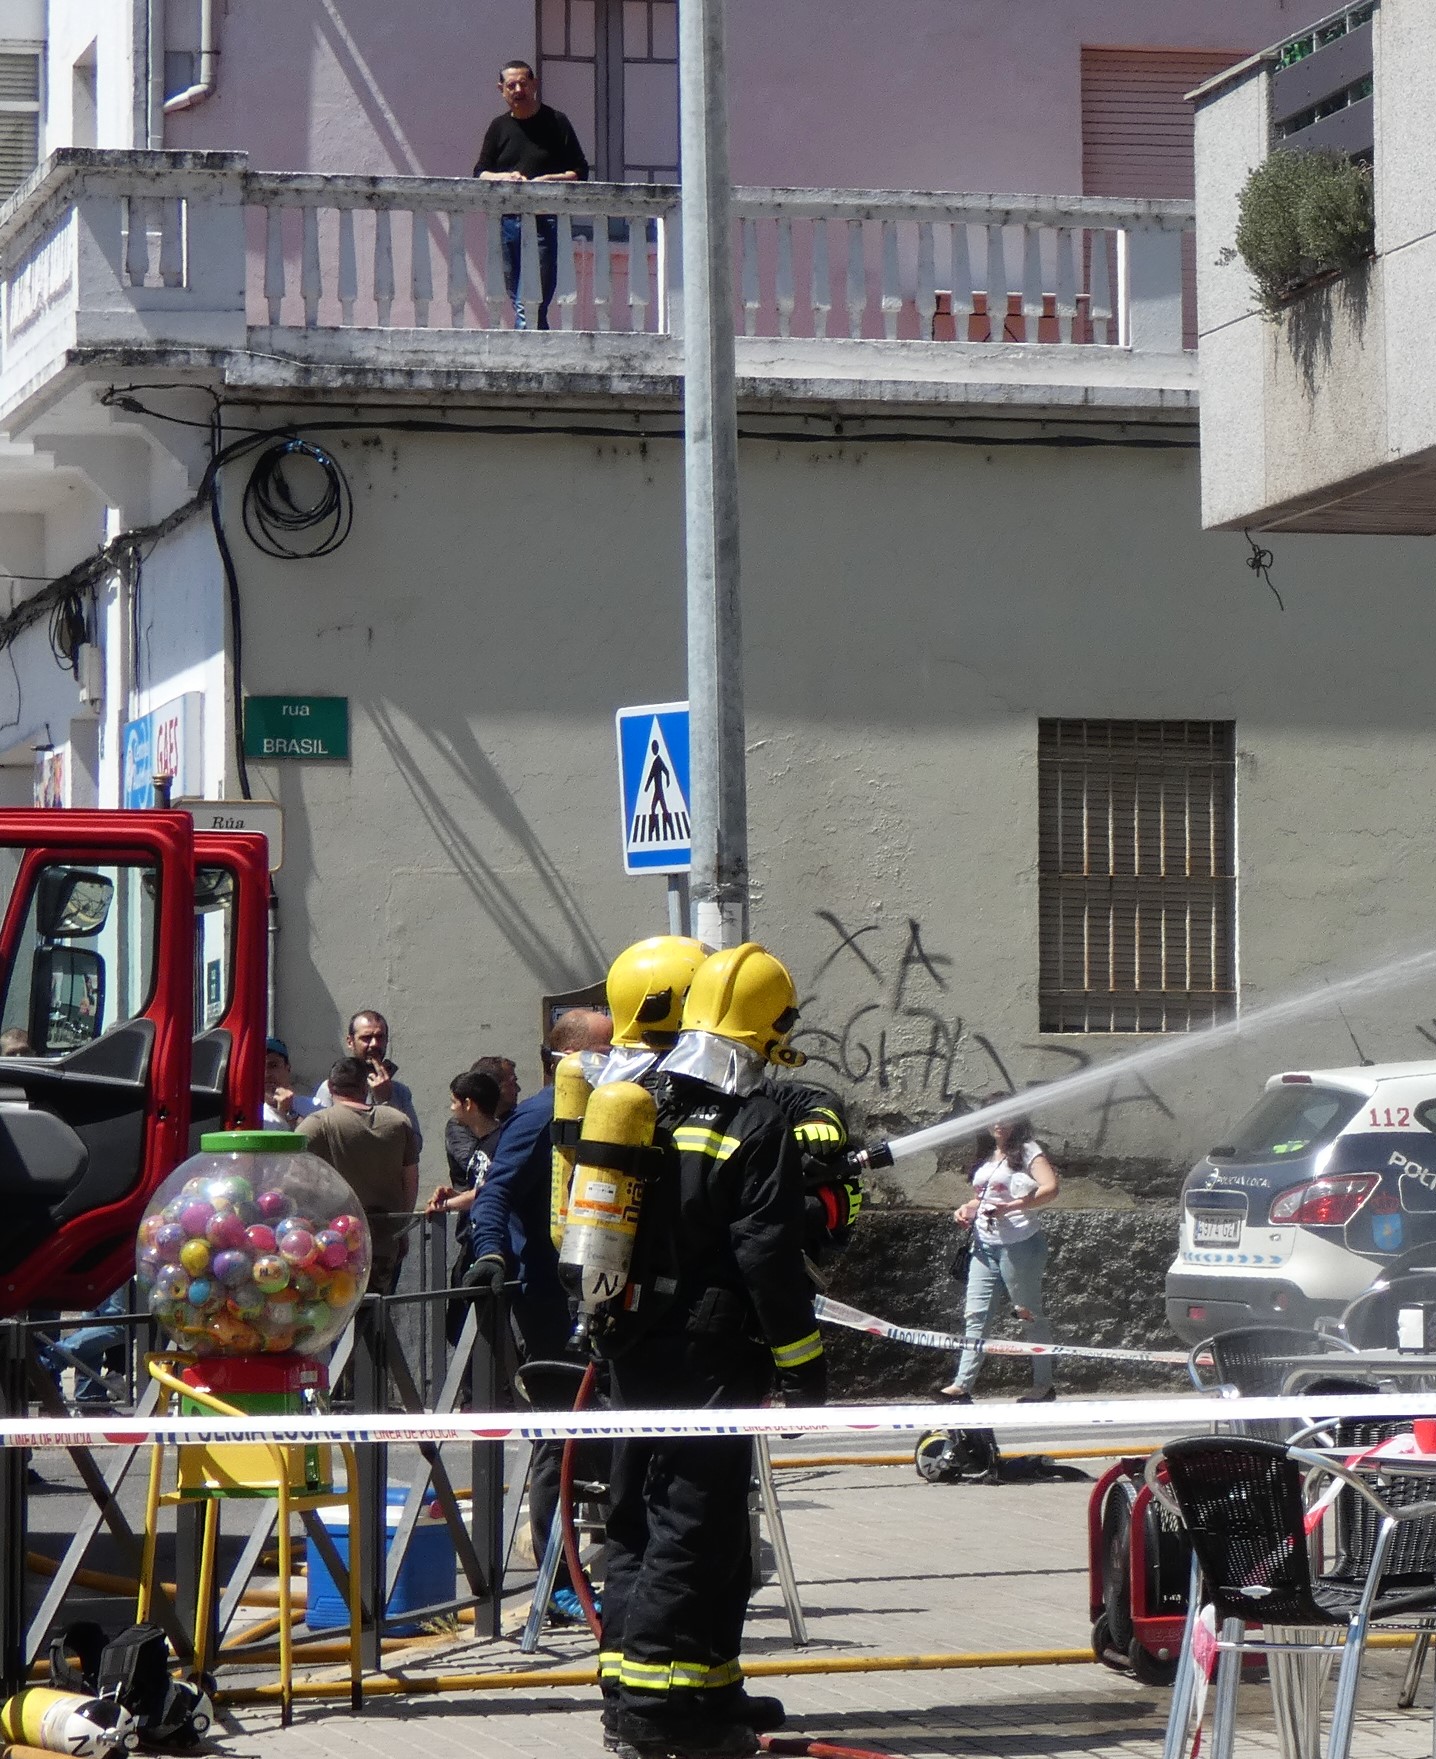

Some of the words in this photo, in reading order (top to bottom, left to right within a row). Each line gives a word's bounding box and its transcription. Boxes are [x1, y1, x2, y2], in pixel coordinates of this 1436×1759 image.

[281, 702, 311, 717] rua
[157, 717, 179, 777] GAES
[262, 737, 329, 755] BRASIL
[211, 815, 246, 829] Rúa
[1369, 1107, 1411, 1127] 112
